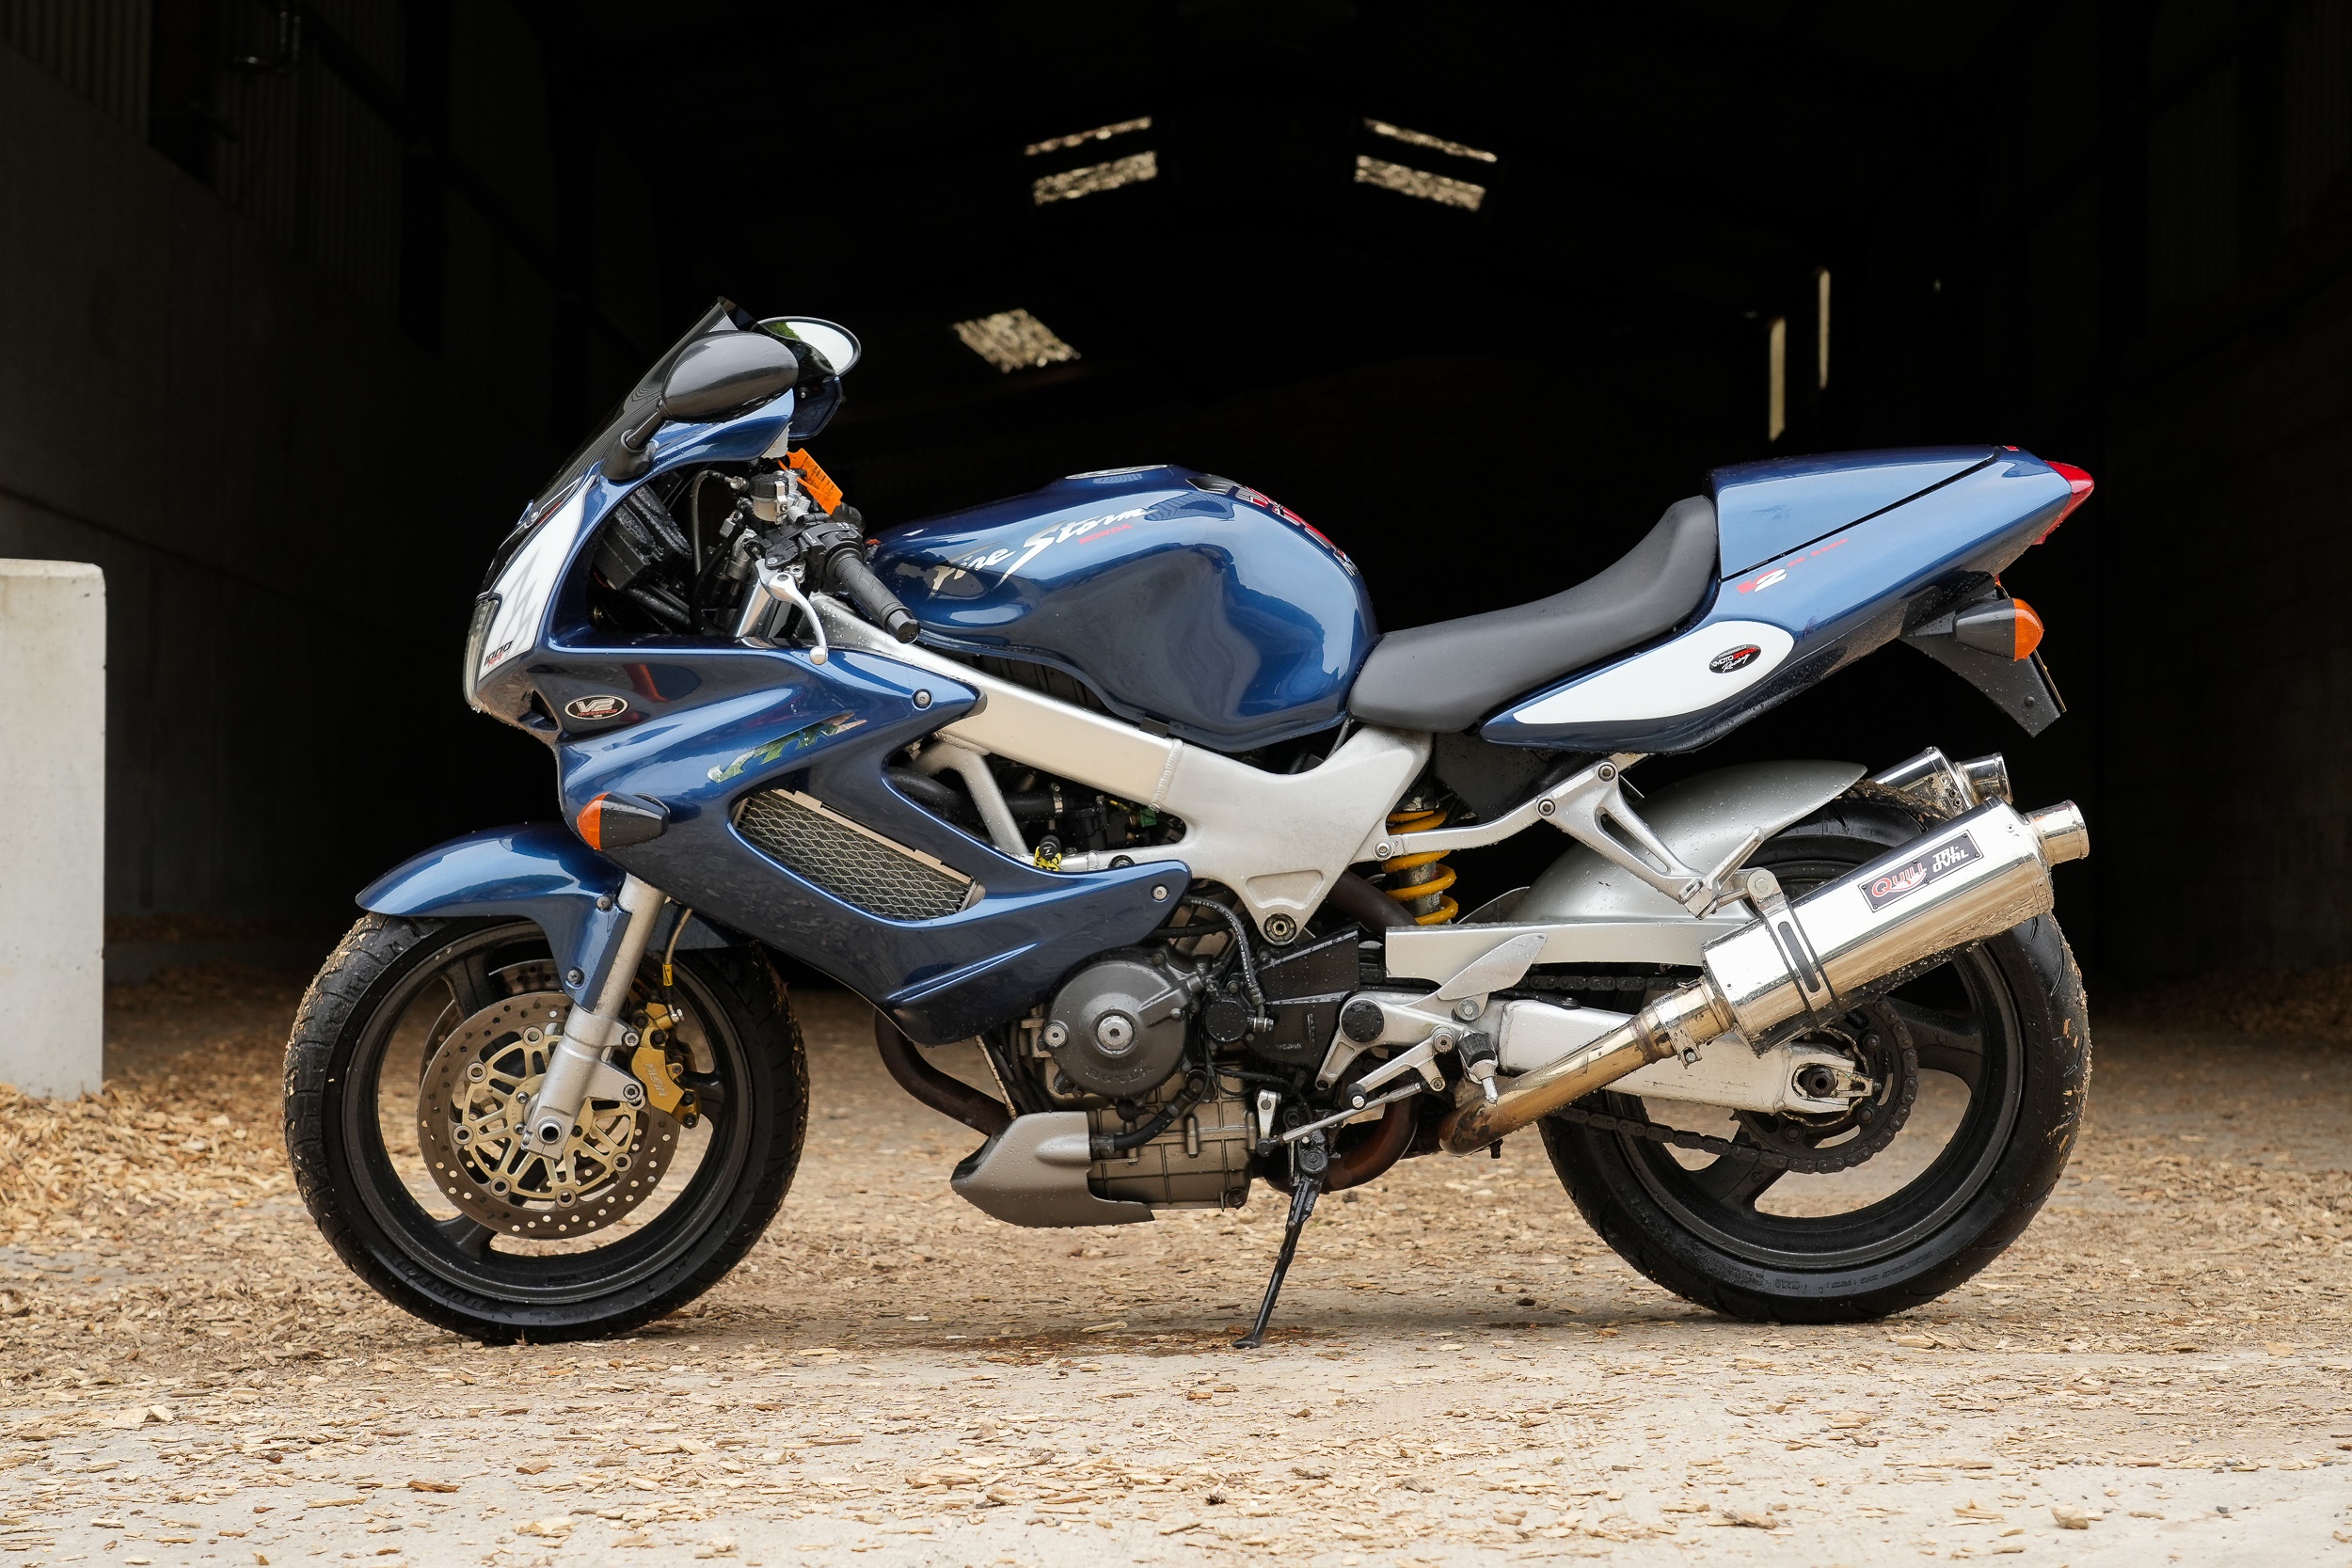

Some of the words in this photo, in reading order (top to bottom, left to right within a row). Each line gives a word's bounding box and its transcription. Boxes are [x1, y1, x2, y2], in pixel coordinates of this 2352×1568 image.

[927, 541, 1016, 600] Fire
[990, 508, 1159, 592] Storm
[576, 697, 615, 713] V2
[1931, 849, 1970, 874] OVAL
[1871, 863, 1928, 898] QUILL
